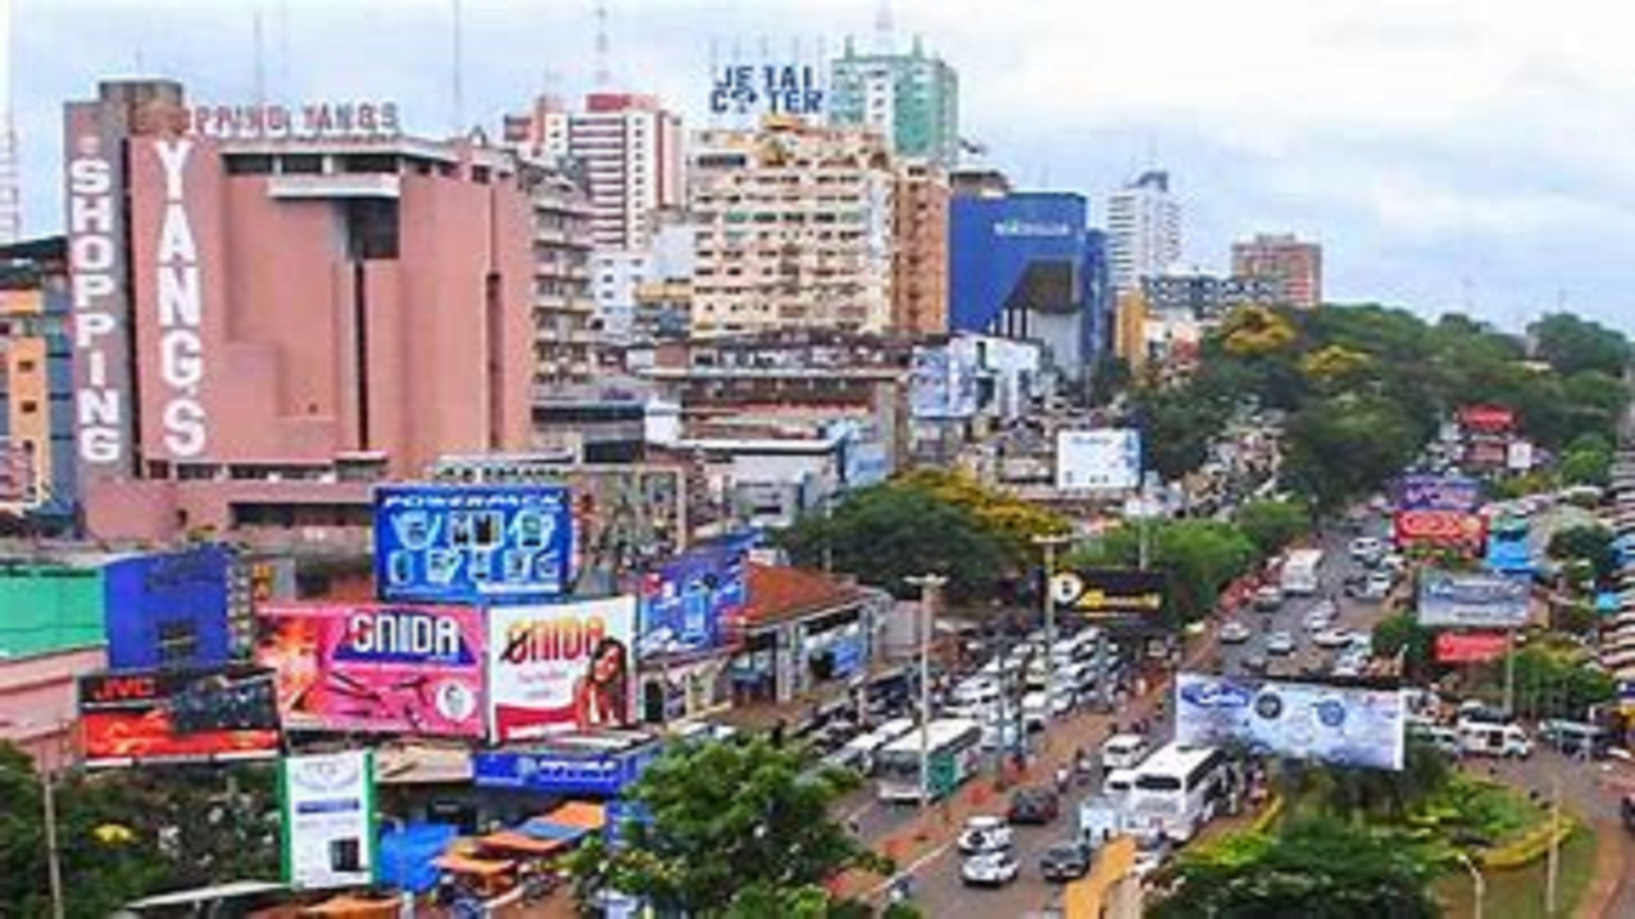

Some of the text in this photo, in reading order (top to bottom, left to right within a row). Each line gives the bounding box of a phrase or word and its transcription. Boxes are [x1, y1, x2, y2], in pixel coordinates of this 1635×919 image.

[70, 158, 121, 463] SHOPPING
[155, 140, 206, 456] YANGS
[94, 678, 156, 700] JVC
